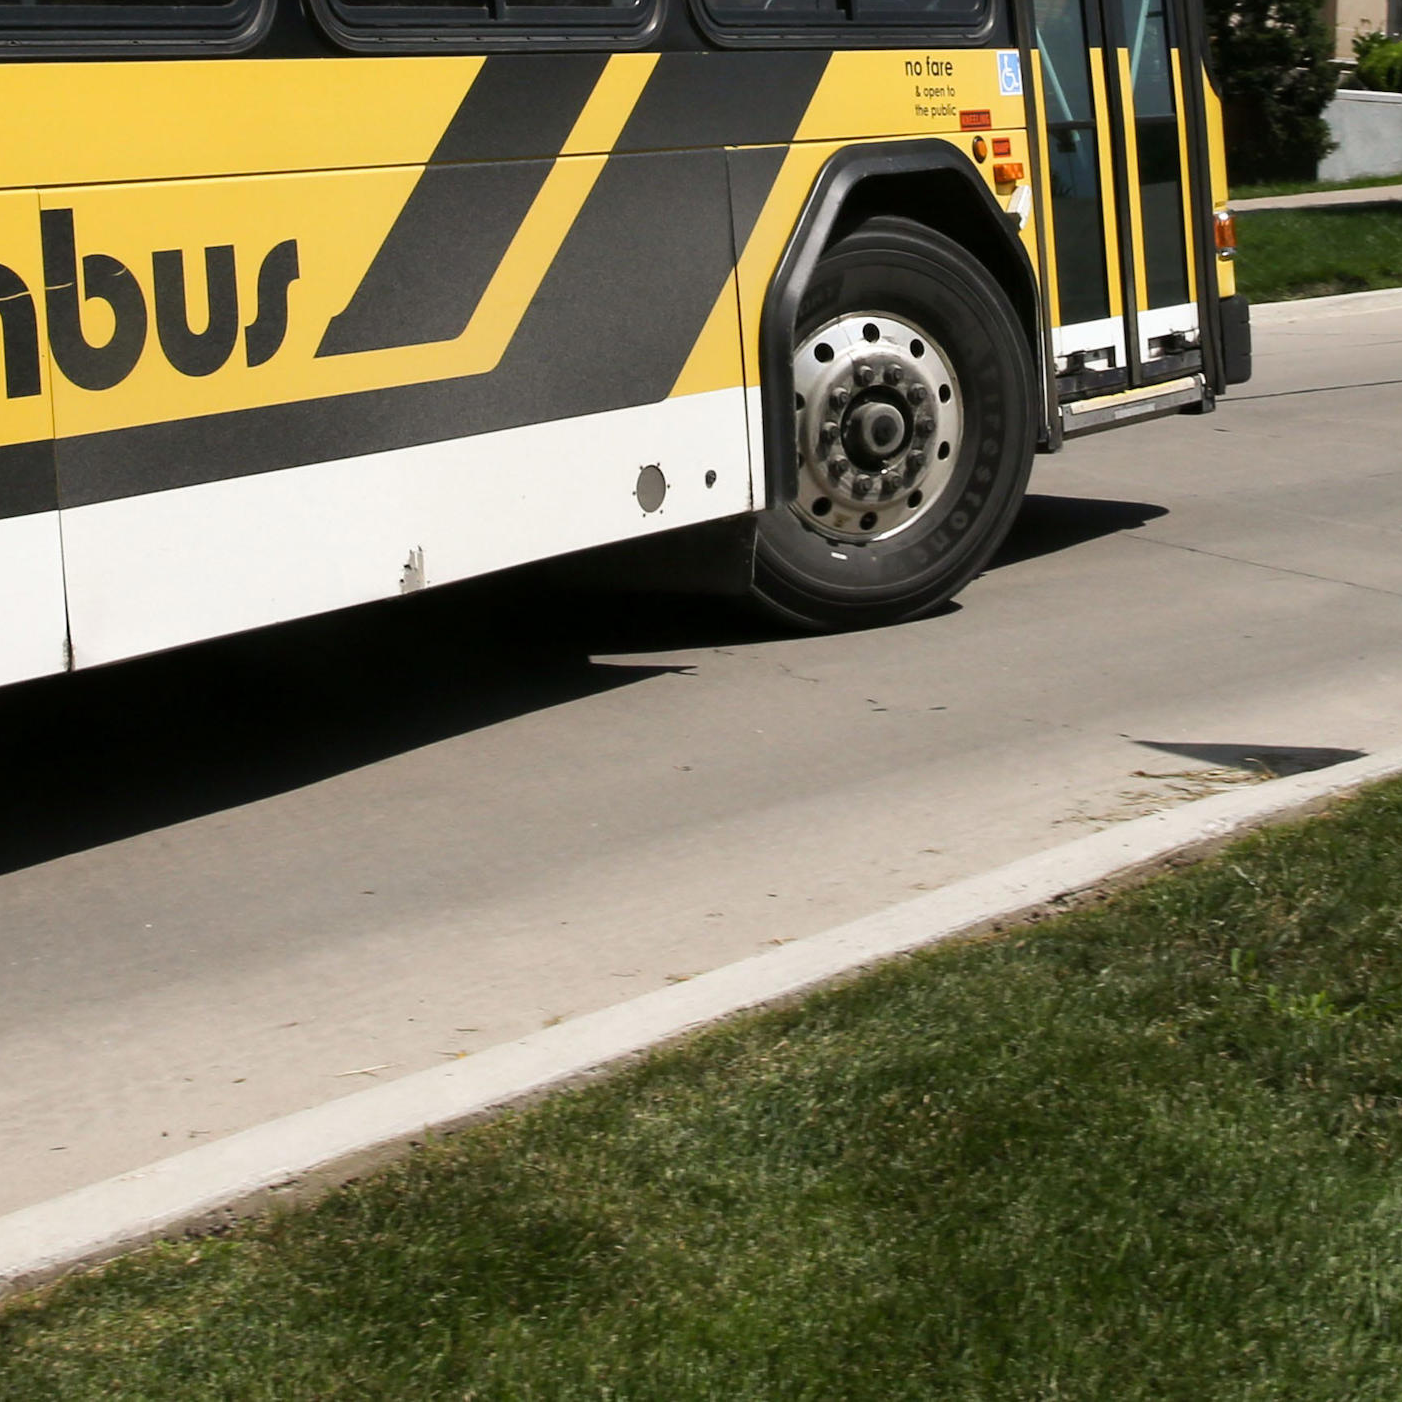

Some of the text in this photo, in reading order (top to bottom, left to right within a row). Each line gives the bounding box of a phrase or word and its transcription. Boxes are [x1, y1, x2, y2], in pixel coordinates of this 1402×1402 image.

[904, 56, 953, 77] no fare
[915, 85, 956, 100] & open to
[915, 103, 957, 119] the public
